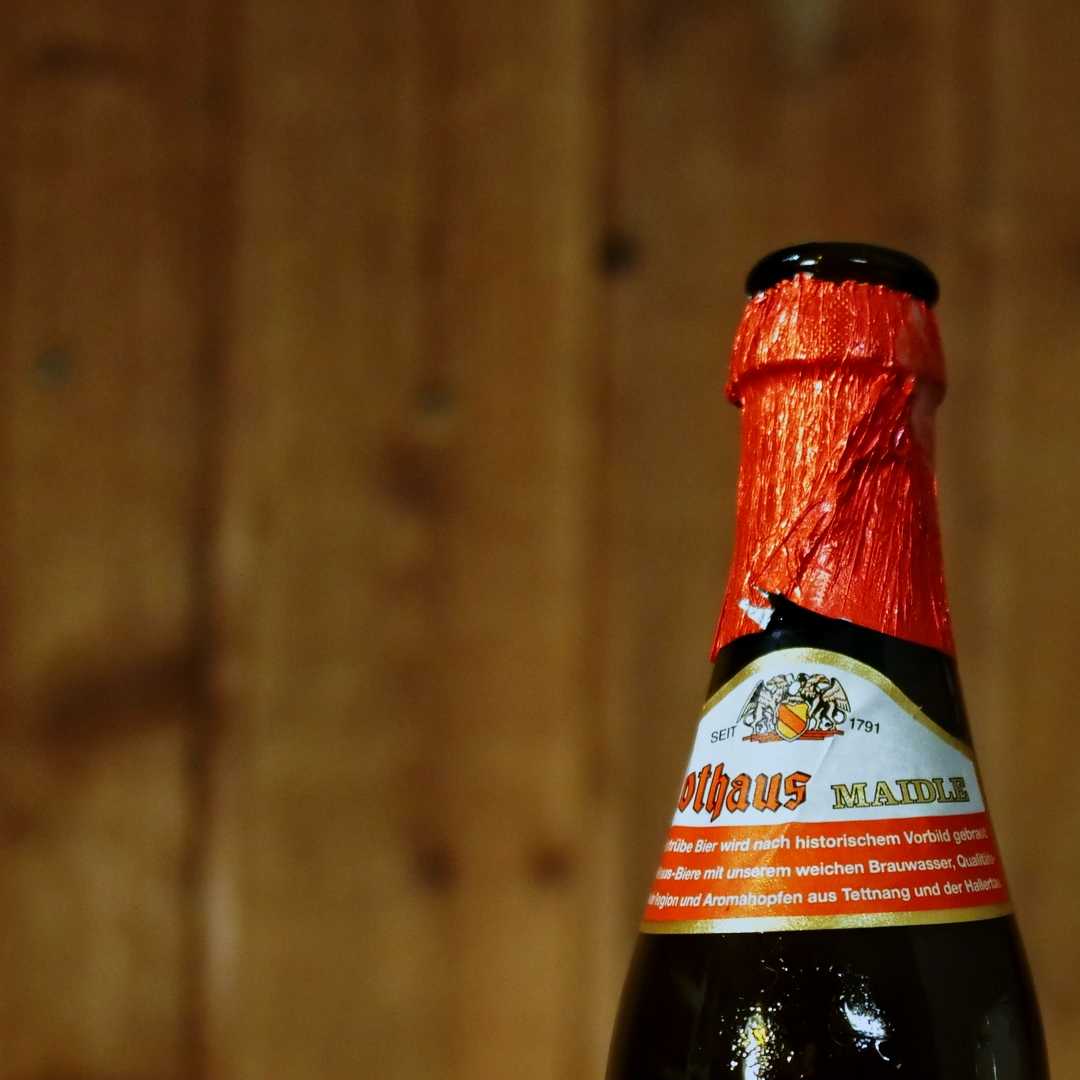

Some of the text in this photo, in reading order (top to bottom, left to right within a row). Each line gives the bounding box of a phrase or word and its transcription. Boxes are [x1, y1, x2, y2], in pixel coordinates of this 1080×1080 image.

[710, 717, 880, 743] SEIT 1791
[830, 777, 970, 809] MAIDLE
[694, 839, 717, 853] Bier
[719, 838, 750, 852] wird
[753, 836, 790, 851] nach
[795, 833, 901, 850] historischem
[903, 829, 951, 845] Vorbild
[703, 866, 725, 880] mit
[726, 867, 791, 880] unserem
[795, 861, 864, 877] weichen
[868, 857, 957, 875] Brauwasser,
[679, 893, 702, 907] und
[703, 889, 803, 908] Aromahopfen
[807, 890, 837, 903] aus
[842, 885, 911, 902] Tettnang
[914, 883, 940, 897] und
[943, 881, 963, 895] der
